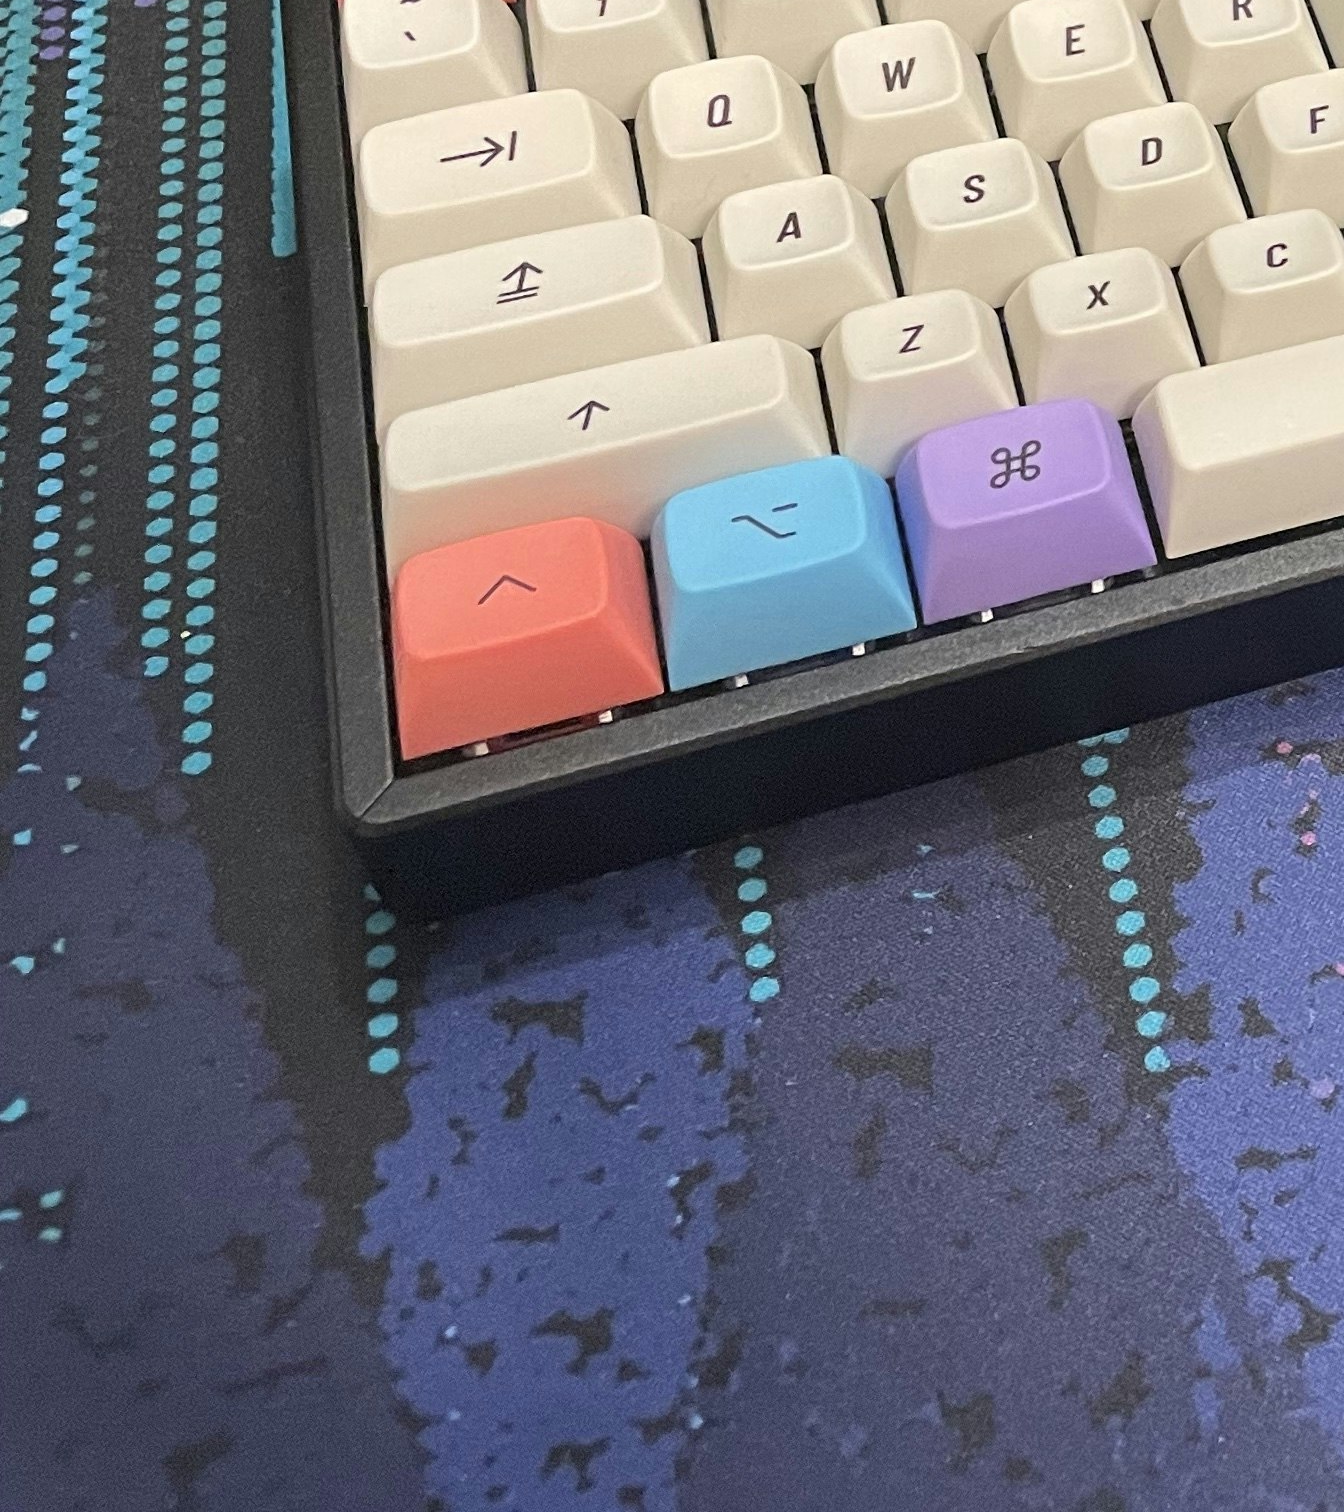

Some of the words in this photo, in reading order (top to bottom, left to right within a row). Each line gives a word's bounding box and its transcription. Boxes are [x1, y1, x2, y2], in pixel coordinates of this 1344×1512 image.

[1065, 24, 1086, 57] E
[881, 57, 916, 93] W
[706, 94, 733, 128] Q
[1309, 104, 1330, 135] F
[1141, 137, 1163, 167] D
[963, 174, 986, 204] S
[776, 211, 802, 243] A
[1266, 243, 1289, 268] C
[1086, 280, 1111, 310] X
[898, 324, 925, 354] Z
